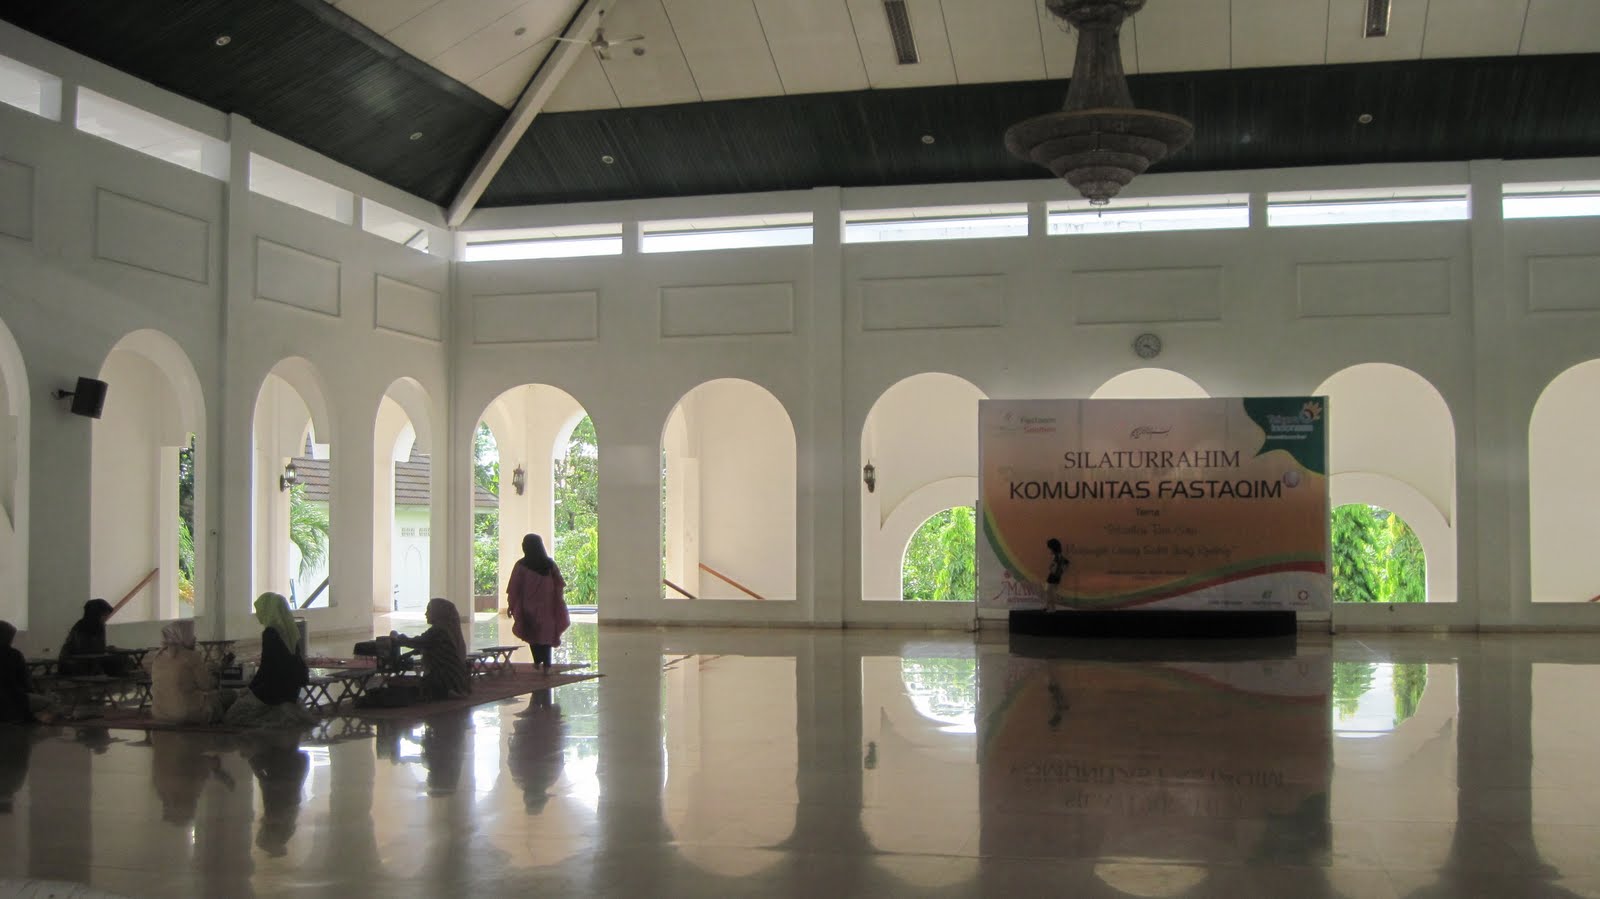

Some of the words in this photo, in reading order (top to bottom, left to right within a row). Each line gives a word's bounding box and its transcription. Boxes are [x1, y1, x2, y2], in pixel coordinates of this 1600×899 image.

[1064, 450, 1240, 469] SILATURRAHIM
[1010, 480, 1150, 499] KOMUNITAS
[1158, 480, 1281, 498] FASTAQIM
